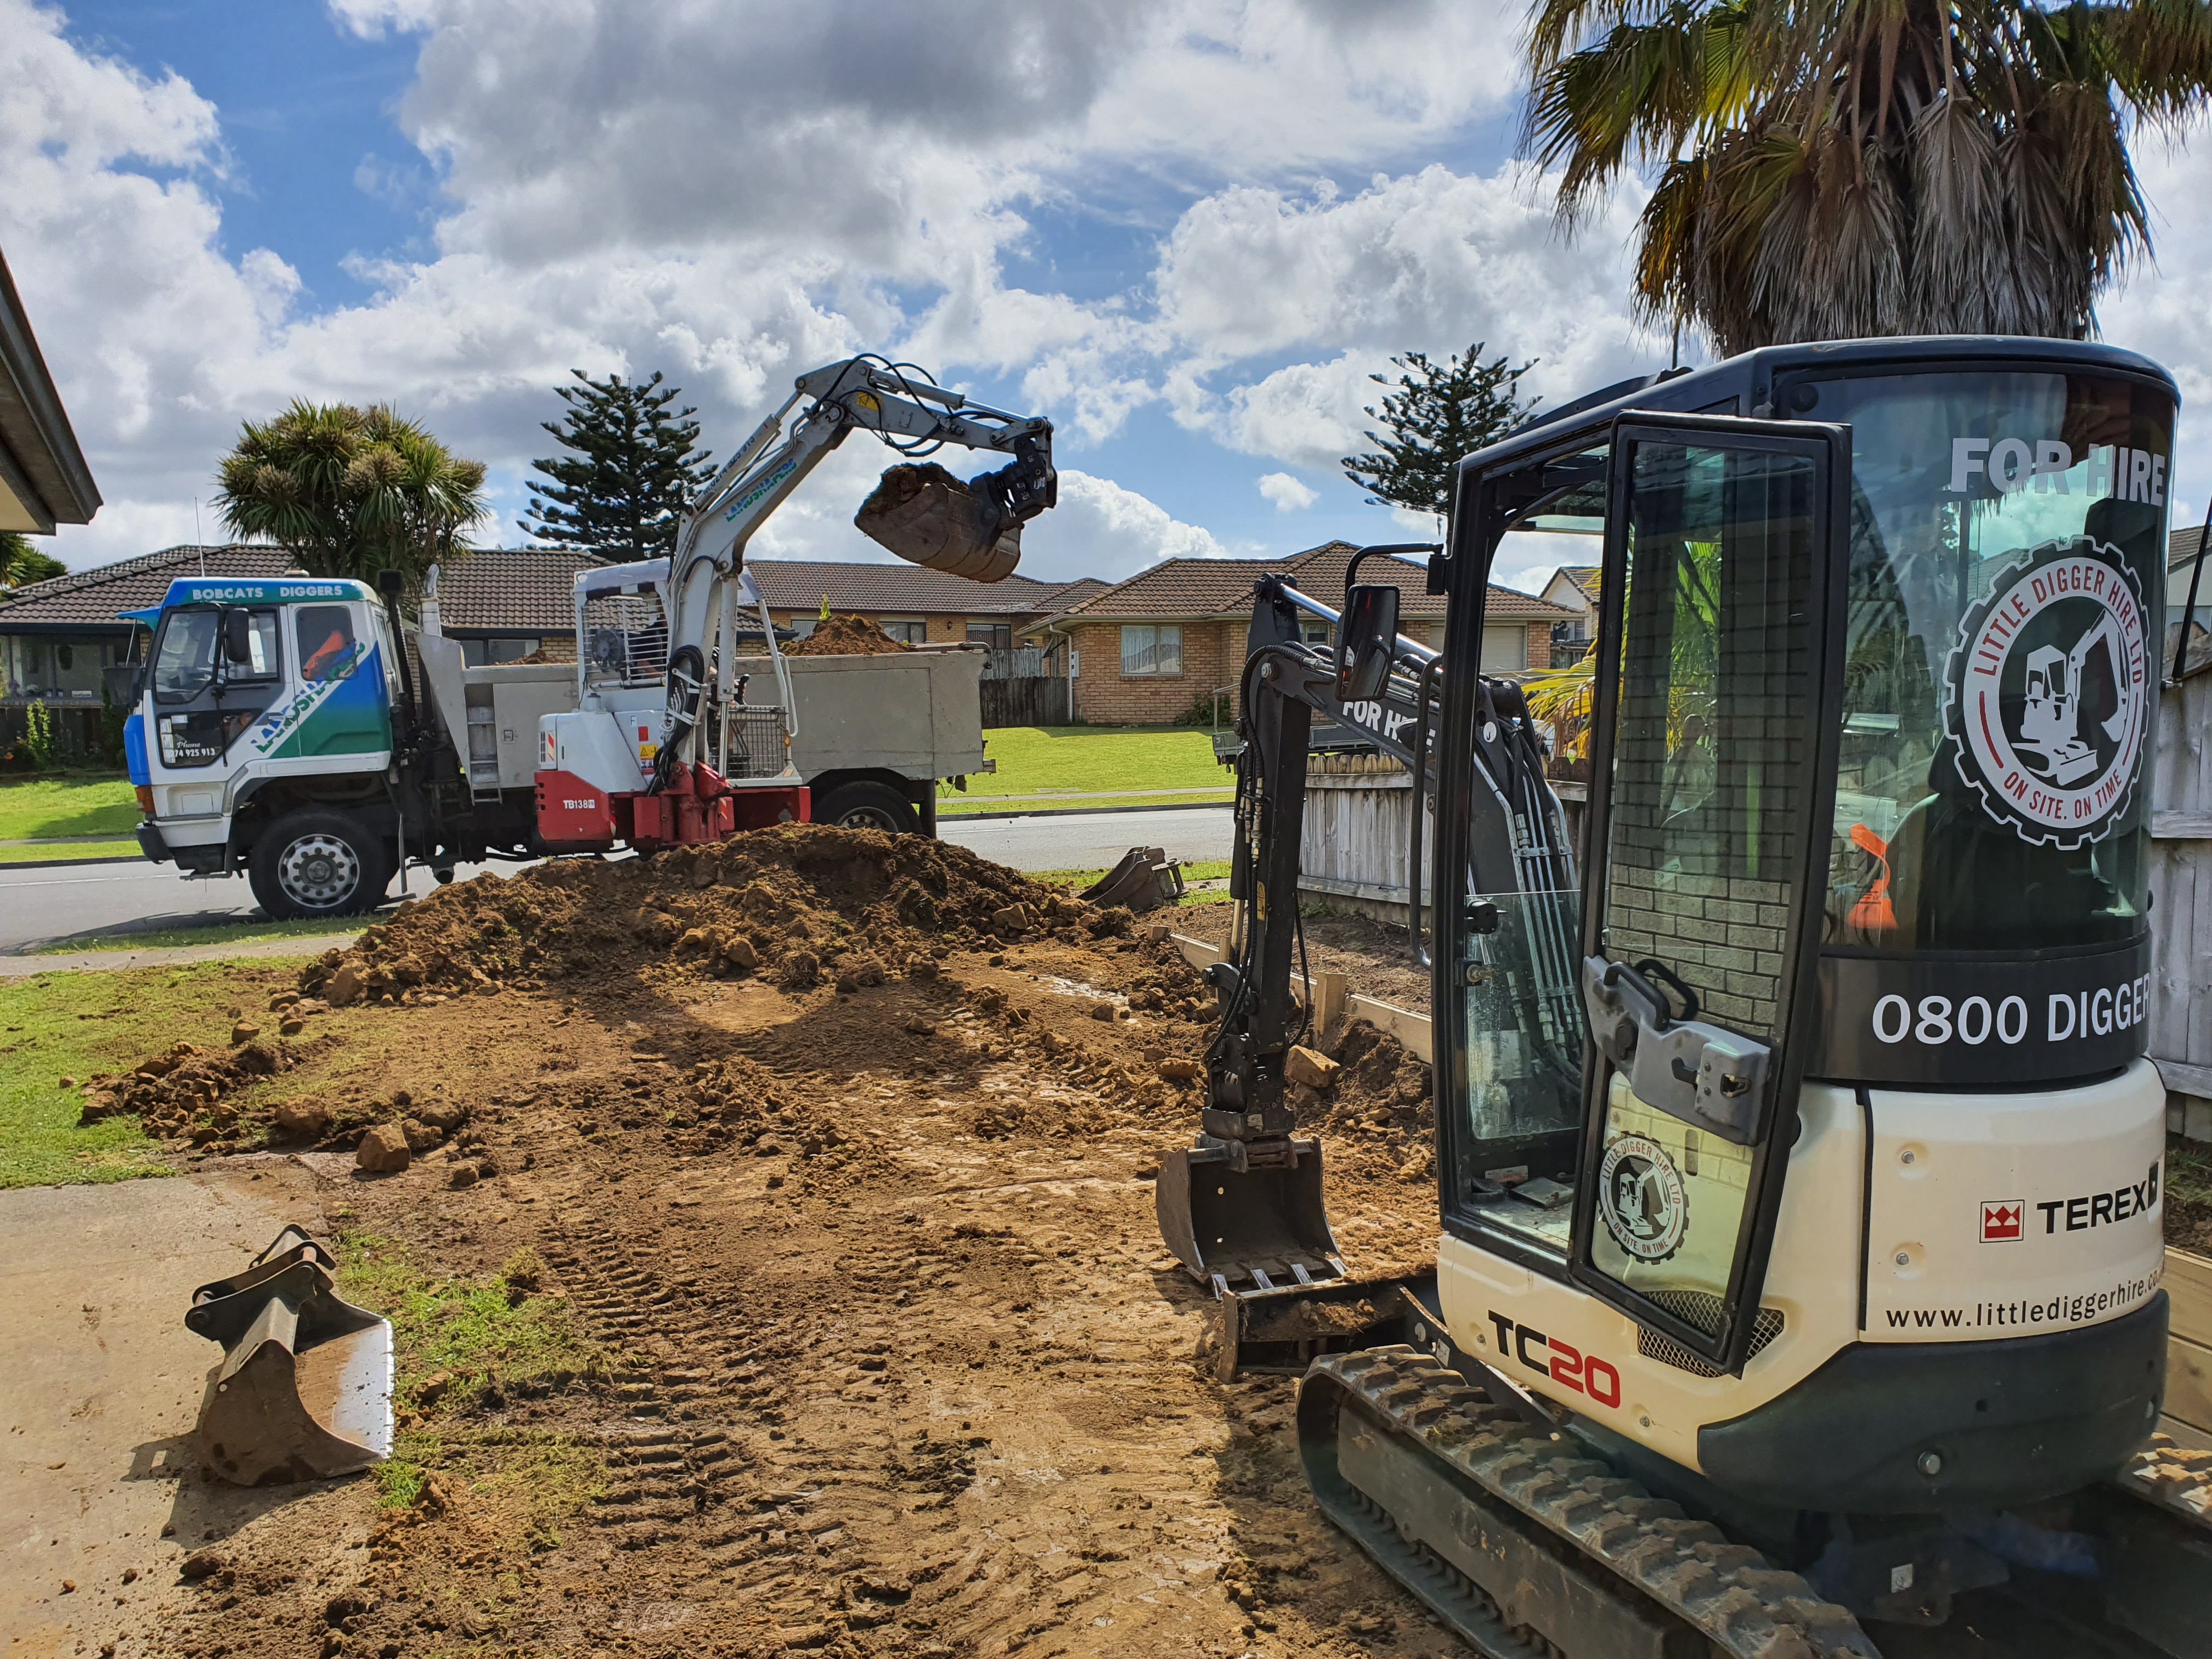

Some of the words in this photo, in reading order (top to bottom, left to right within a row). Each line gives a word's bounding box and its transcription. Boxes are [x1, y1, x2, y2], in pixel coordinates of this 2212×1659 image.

[1950, 438, 2072, 495] FOR
[2086, 443, 2165, 507] HIRE
[193, 587, 263, 600] BOBCATS
[280, 585, 342, 597] DIGGERS
[1974, 593, 2031, 676] LITTLE
[2031, 565, 2105, 605] DIGGER
[2107, 580, 2137, 637] HIRE
[2129, 639, 2142, 684] LTD
[1342, 701, 1381, 732] FOR
[177, 740, 201, 748] Phone
[185, 749, 199, 757] 925
[201, 748, 216, 756] 913
[2004, 771, 2029, 800] ON
[2029, 790, 2067, 820] SITE.
[2074, 799, 2092, 820] ON
[2095, 768, 2122, 811] TIME
[1872, 995, 2028, 1045] 0800
[2047, 972, 2149, 1042] DIGGER
[1602, 1148, 1621, 1181] LITTLE
[1621, 1141, 1652, 1156] DIGGER
[1654, 1153, 1673, 1181] HIRE
[1669, 1183, 1681, 1205] LTD
[2036, 1180, 2146, 1234] TEREX
[1613, 1222, 1623, 1235] ON
[1623, 1234, 1639, 1251] SITE.
[1642, 1243, 1651, 1254] ON
[1652, 1238, 1668, 1254] TIME
[1488, 1309, 1621, 1409] TC20
